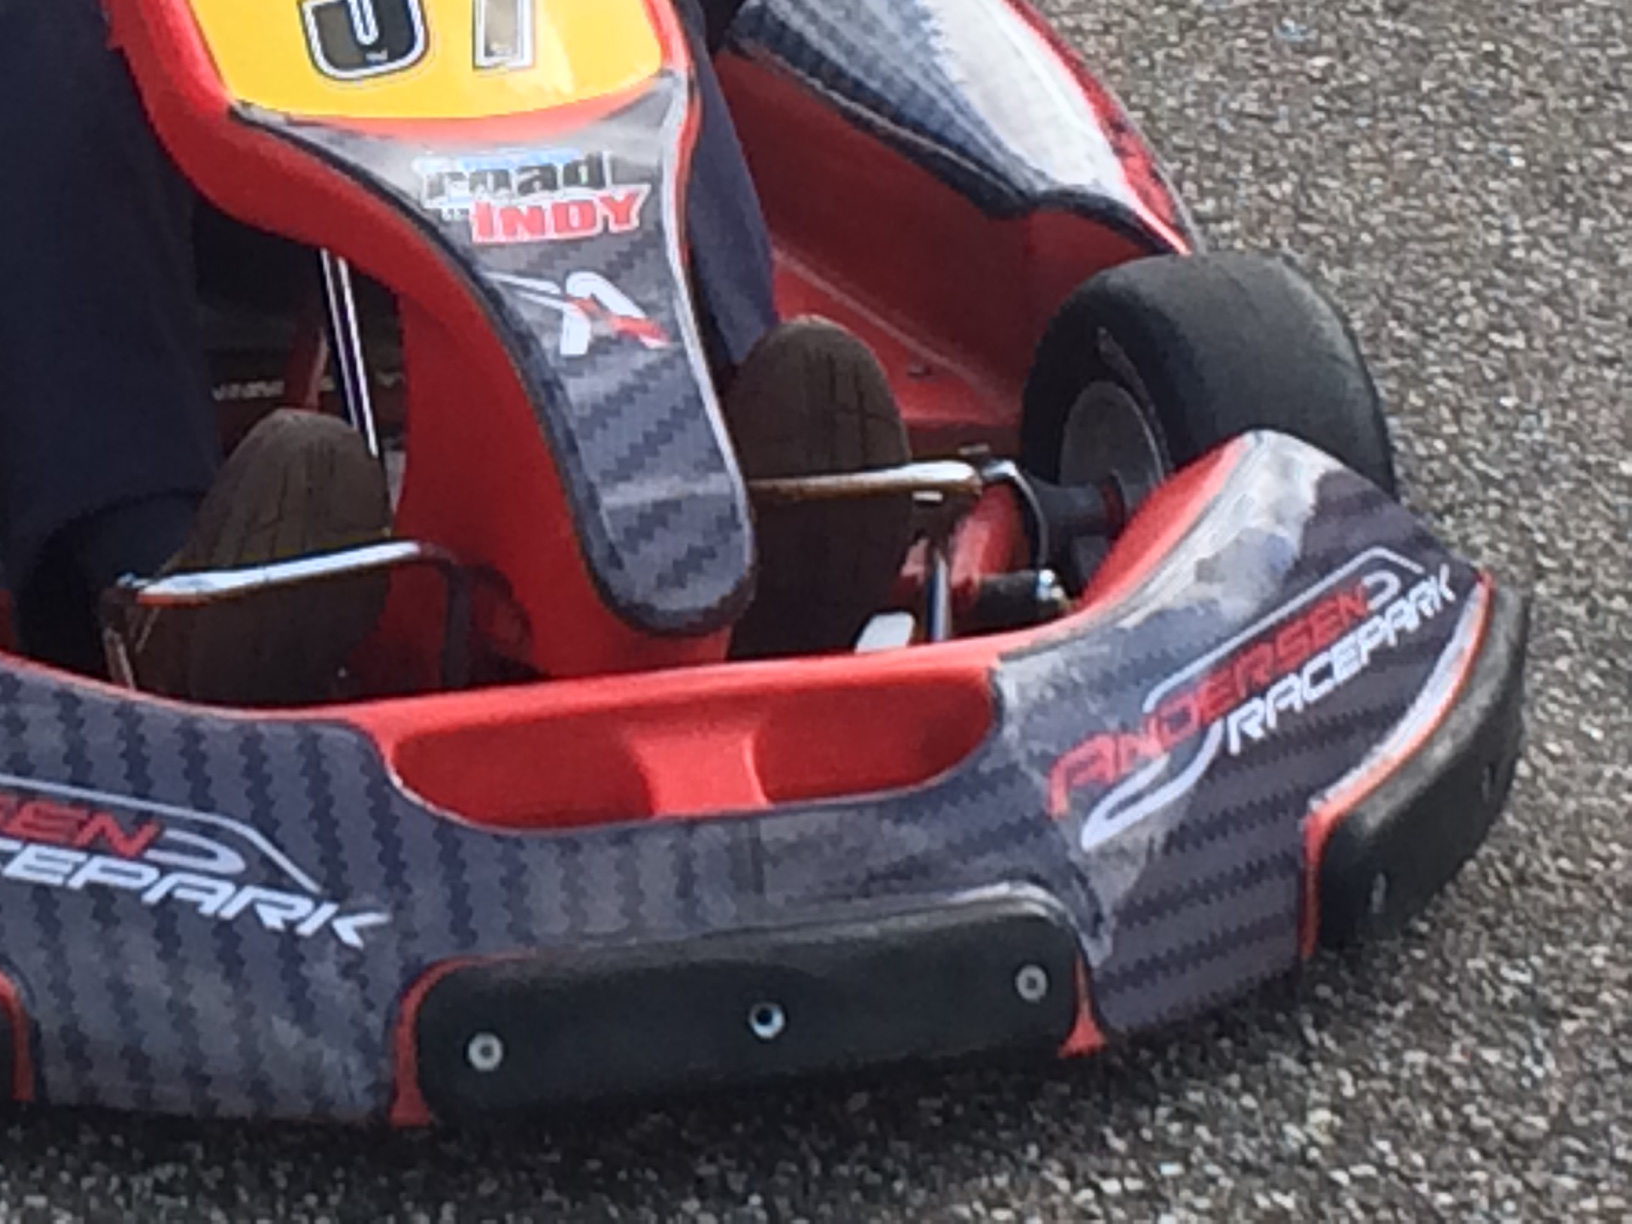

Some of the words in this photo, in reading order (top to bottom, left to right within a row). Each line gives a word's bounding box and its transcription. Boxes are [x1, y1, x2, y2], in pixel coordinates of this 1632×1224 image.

[471, 185, 651, 243] INDY
[1046, 582, 1369, 820] ANDERSEN
[1226, 564, 1457, 756] RACEPARK
